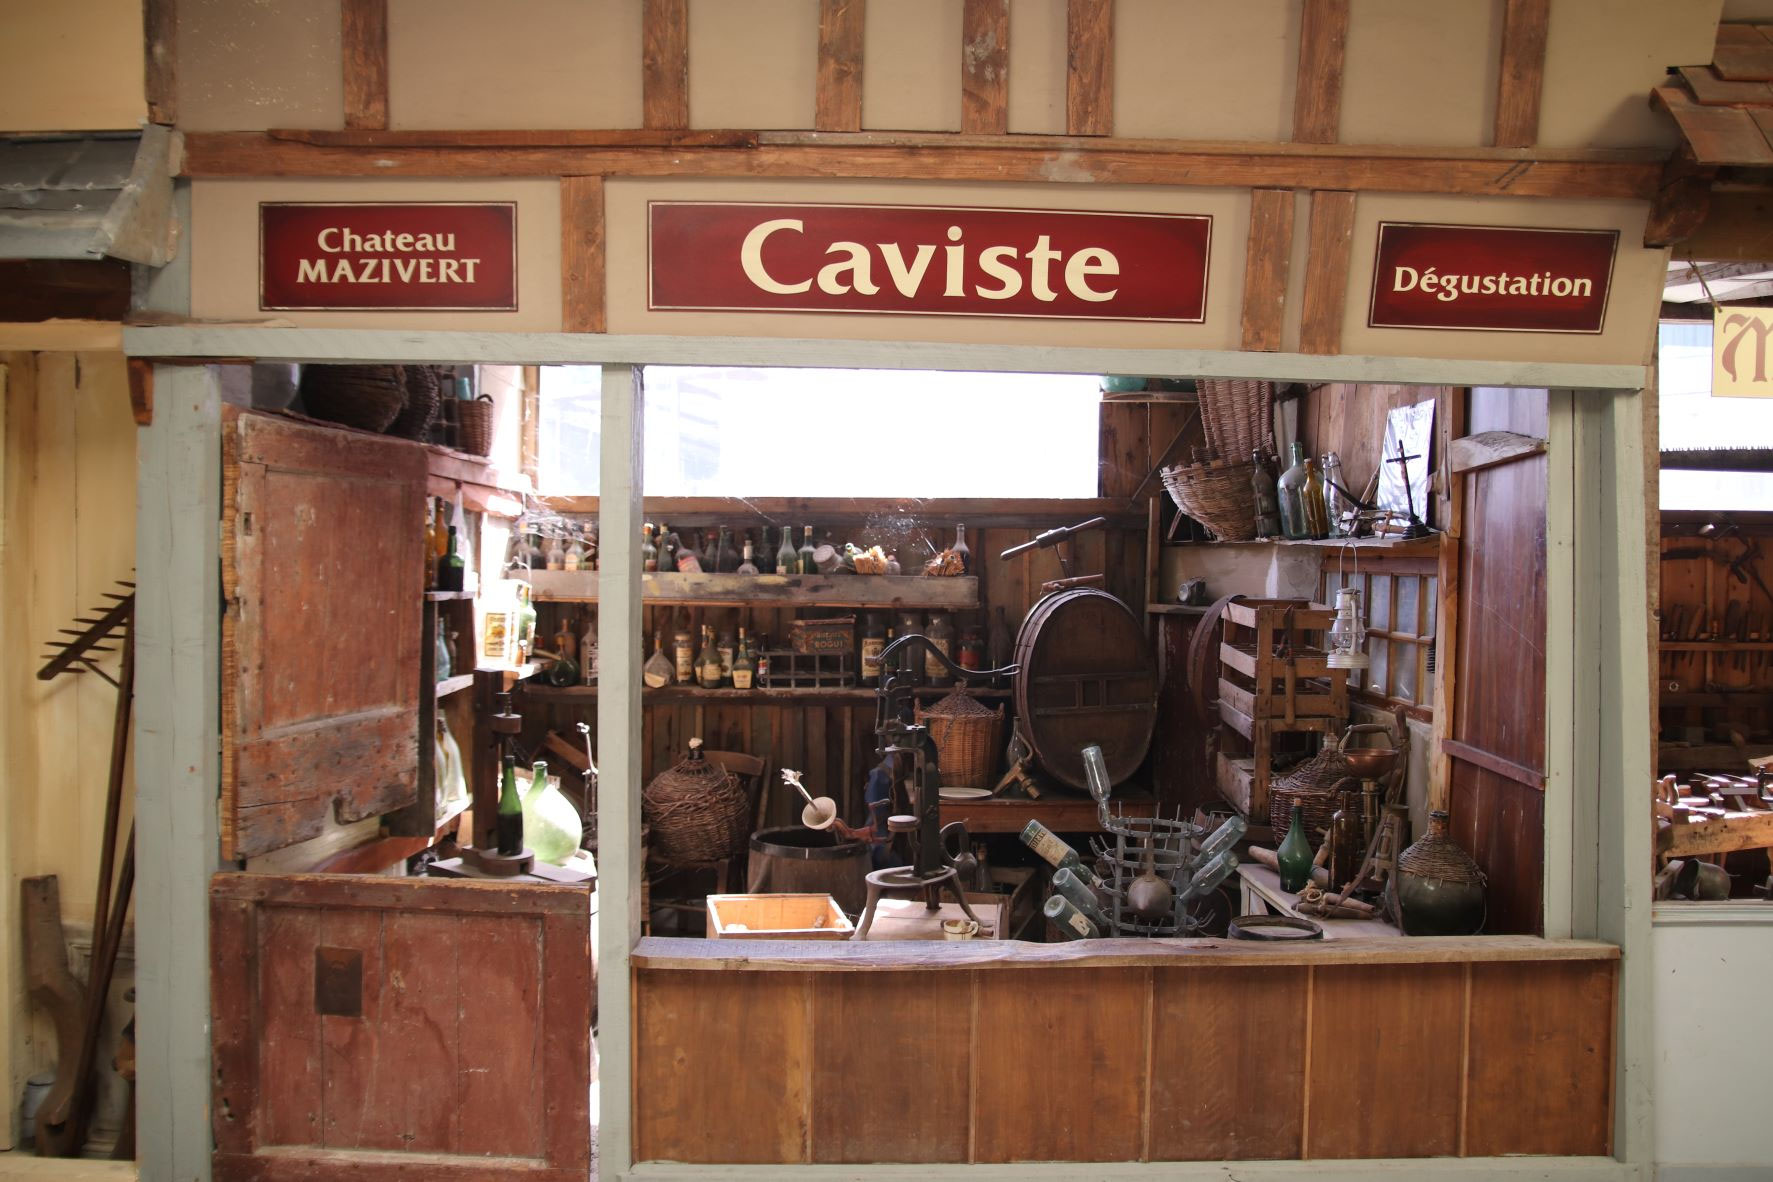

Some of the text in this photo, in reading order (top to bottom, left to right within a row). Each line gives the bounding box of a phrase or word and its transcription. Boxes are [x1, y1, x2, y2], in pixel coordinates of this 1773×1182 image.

[317, 227, 456, 252] Chateau
[296, 258, 481, 283] MAZIVERT
[740, 218, 1120, 302] Caviste
[1392, 266, 1592, 302] Dégustation
